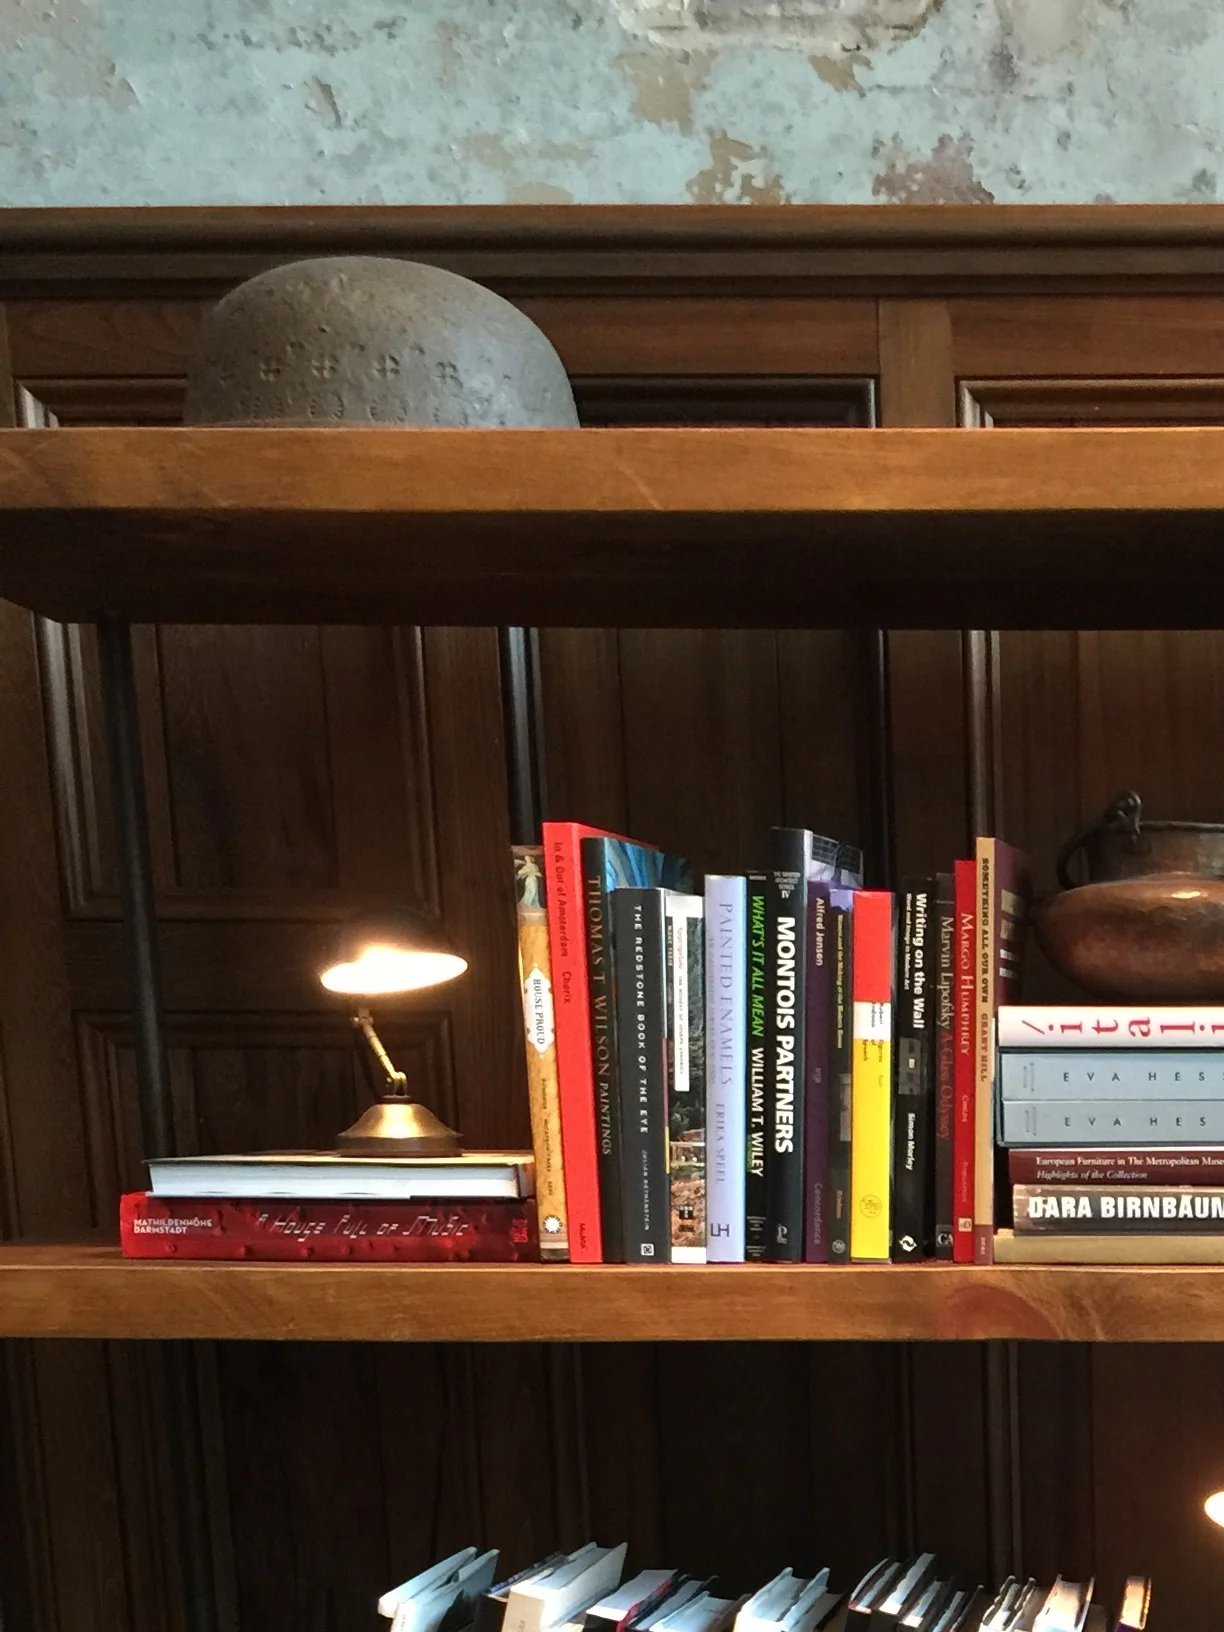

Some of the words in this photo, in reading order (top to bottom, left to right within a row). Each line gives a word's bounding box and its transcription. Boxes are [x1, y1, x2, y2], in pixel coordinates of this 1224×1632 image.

[557, 899, 570, 957] Amsterdam
[588, 874, 605, 966] THOMAS
[633, 905, 643, 930] THE
[751, 895, 765, 949] WHAT'S
[815, 897, 826, 930] Alfred
[913, 893, 928, 947] Writing
[719, 903, 733, 988] PAINTED
[815, 933, 826, 966] Jensen
[940, 915, 955, 968] Marvin
[960, 912, 974, 970] MARGO
[981, 930, 990, 947] ALL
[634, 936, 646, 1008] REDSTONE
[751, 952, 765, 965] IT
[776, 917, 796, 1029] MONTOIS
[913, 949, 925, 967] on
[981, 950, 990, 976] OUR
[532, 978, 544, 1010] HOUSE
[751, 968, 765, 991] ALL
[913, 970, 928, 995] the
[981, 979, 989, 1004] OWN
[751, 995, 765, 1037] MEAN
[912, 998, 926, 1029] Wall
[936, 972, 955, 1030] Lipofsky
[960, 975, 974, 1057] HUMPHREY
[535, 1012, 546, 1045] PROUD
[593, 994, 611, 1076] WILSON
[637, 1013, 646, 1049] BOOK
[719, 996, 734, 1086] ENAMELS
[638, 1055, 647, 1072] OF
[751, 1047, 765, 1112] WILLIAM
[1063, 1071, 1121, 1083] EVA
[639, 1078, 648, 1103] THE
[774, 1035, 795, 1154] PARTNERS
[600, 1082, 613, 1156] PAINTINGS
[640, 1109, 649, 1134] EYE
[715, 1103, 725, 1142] ERIKA
[1064, 1115, 1122, 1127] EVA
[715, 1146, 725, 1184] SPEEL
[751, 1132, 765, 1178] WILEY
[1036, 1156, 1075, 1168] European
[1077, 1156, 1114, 1166] Furniture
[1127, 1156, 1144, 1166] The
[1146, 1155, 1200, 1168] Metropolitan
[1028, 1195, 1092, 1219] DARA
[133, 1226, 188, 1235] DARMSTADT
